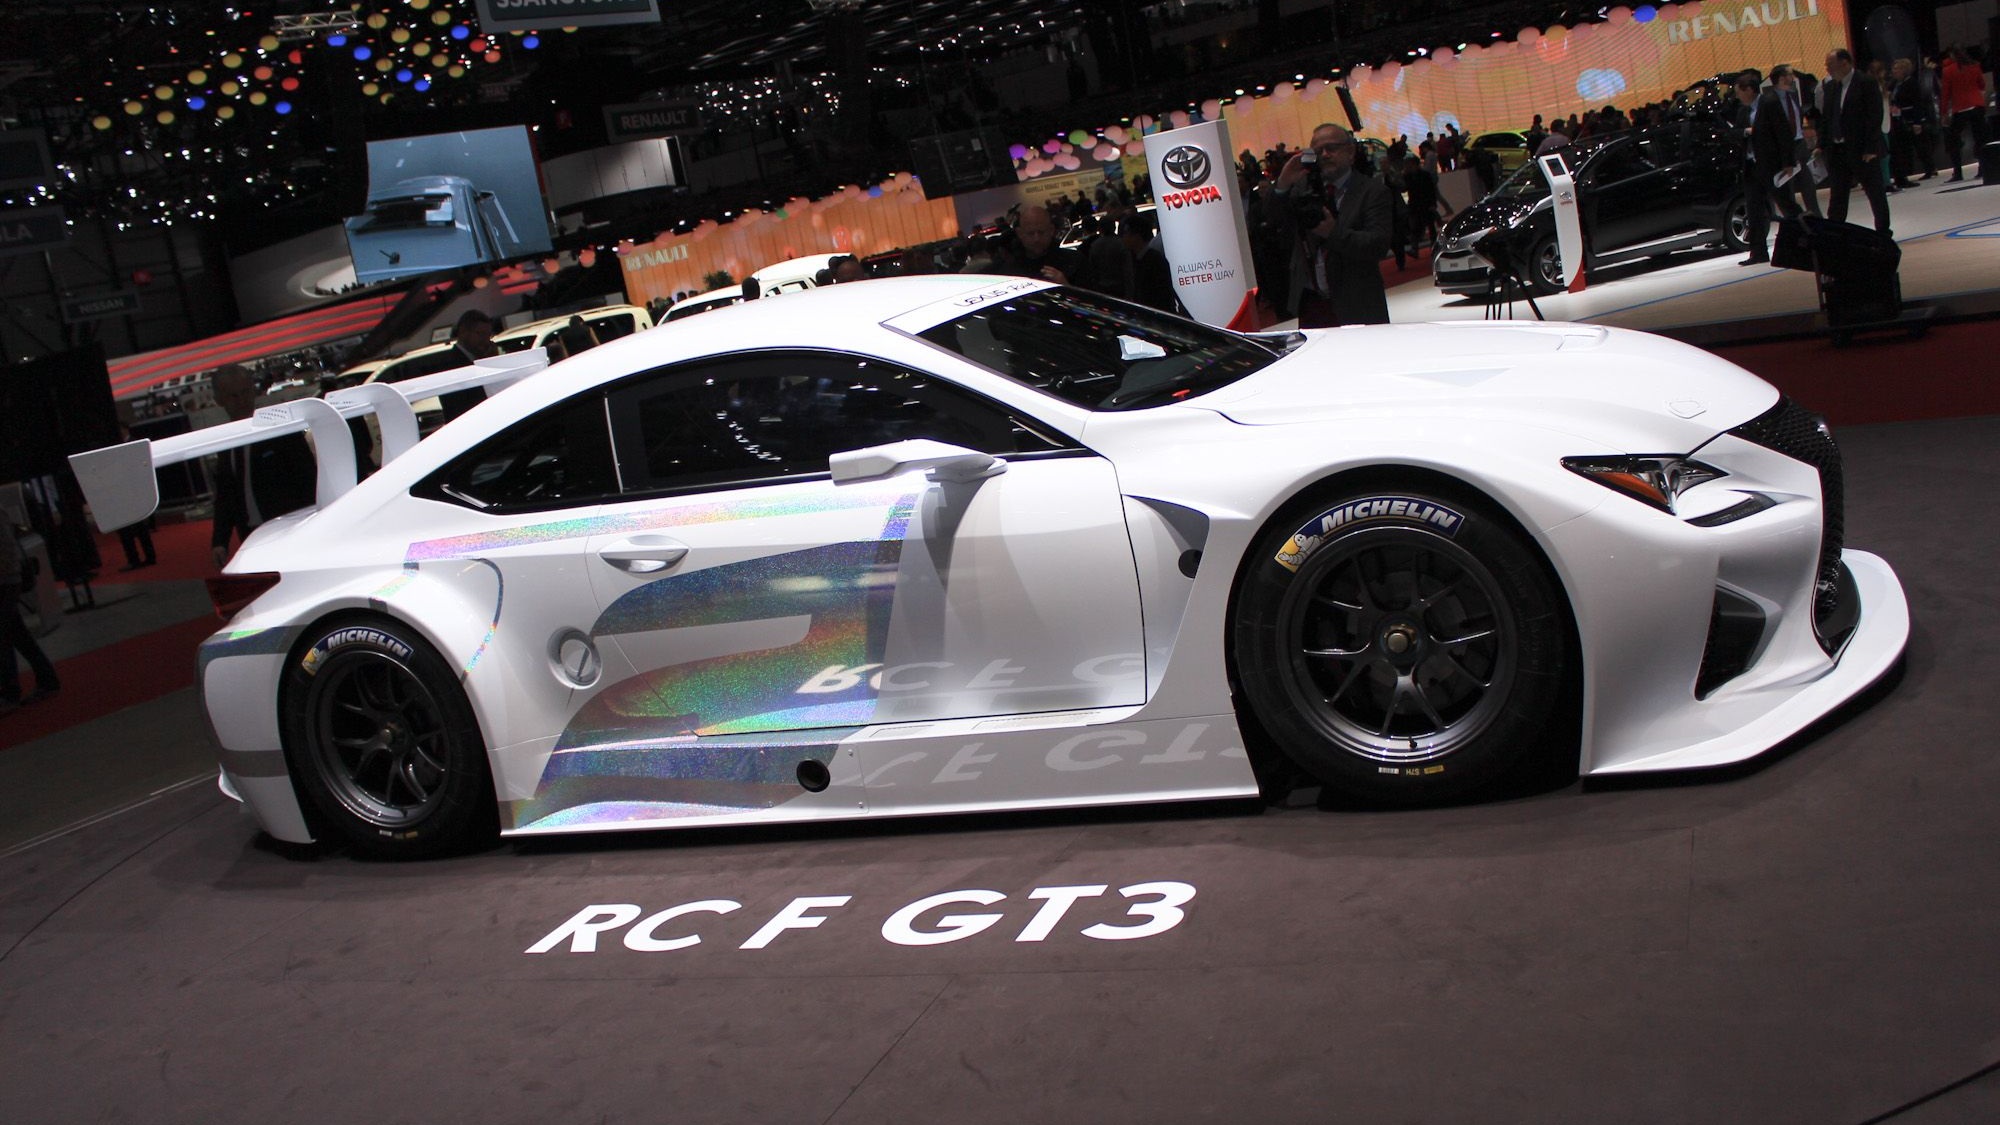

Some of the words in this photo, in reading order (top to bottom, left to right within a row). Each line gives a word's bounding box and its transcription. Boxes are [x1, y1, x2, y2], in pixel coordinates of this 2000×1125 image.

[1668, 0, 1818, 45] RENAULT
[620, 110, 687, 130] RENAULT
[1162, 186, 1222, 211] TOYOTA
[0, 223, 33, 243] LA
[1177, 260, 1214, 274] ALWAYS
[1215, 259, 1223, 269] A
[1178, 274, 1213, 286] BETTER
[1214, 269, 1235, 281] WAY
[79, 298, 125, 314] NISSAN
[1321, 500, 1457, 534] MICHELIN
[327, 630, 409, 658] MICHELIN
[524, 900, 743, 953] RC
[738, 895, 853, 950] F
[881, 881, 1197, 946] GT3
